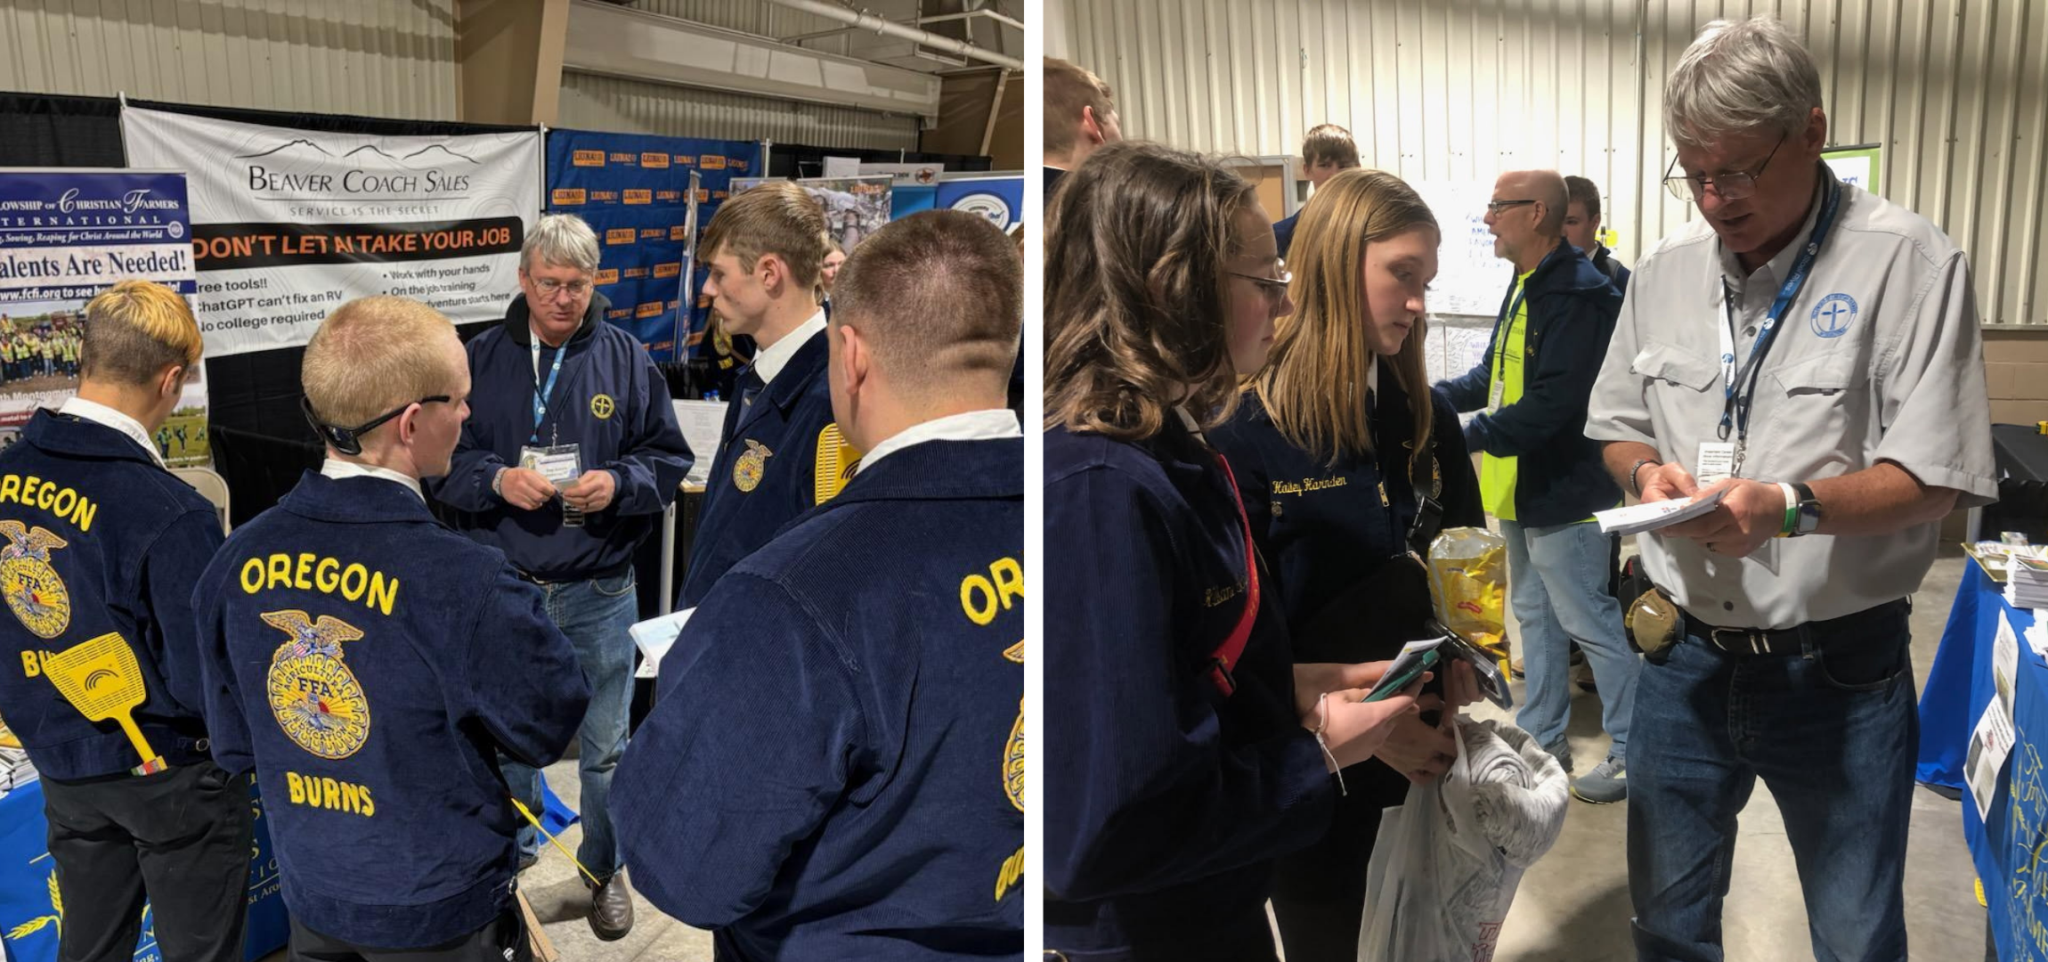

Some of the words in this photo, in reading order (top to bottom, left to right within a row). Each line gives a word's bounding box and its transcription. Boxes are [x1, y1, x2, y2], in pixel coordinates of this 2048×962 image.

[249, 166, 332, 192] BEAVER
[343, 170, 417, 193] COACH
[424, 170, 469, 193] SALES
[57, 188, 122, 213] CHRISTIAN
[123, 189, 179, 214] FARMERS
[290, 206, 346, 217] SERVICE
[353, 206, 367, 216] IS
[370, 206, 391, 216] THE
[397, 205, 439, 216] SECRET
[36, 232, 67, 244] Reaping
[68, 231, 80, 243] for
[80, 231, 102, 241] Christ
[103, 230, 130, 240] Around
[130, 230, 142, 239] the
[142, 229, 163, 239] World
[193, 235, 276, 259] DON’T
[282, 235, 328, 255] LET
[356, 232, 417, 252] TAKE
[421, 230, 473, 250] YOUR
[477, 228, 511, 247] JOB
[65, 253, 103, 276] Are
[108, 250, 187, 275] Needed!
[389, 270, 414, 280] Work
[415, 268, 437, 279] with
[438, 267, 461, 279] your
[463, 264, 490, 274] hands
[63, 287, 74, 297] to
[75, 288, 92, 297] see
[197, 282, 222, 293] ree
[225, 278, 268, 291] tools!!
[391, 287, 407, 296] On
[408, 285, 425, 295] the
[425, 285, 439, 295] job
[440, 281, 476, 293] training
[293, 292, 308, 304] fix
[310, 292, 325, 303] an
[326, 290, 343, 301] RV
[426, 297, 467, 308] venture
[468, 295, 489, 304] starts
[490, 292, 510, 301] here
[216, 315, 268, 330] college
[271, 309, 325, 325] required
[0, 474, 97, 532] REGON
[18, 572, 43, 591] FFA
[240, 553, 399, 616] OREGON
[960, 556, 1024, 625] OR
[299, 677, 334, 699] FFA
[286, 771, 375, 818] BURNS
